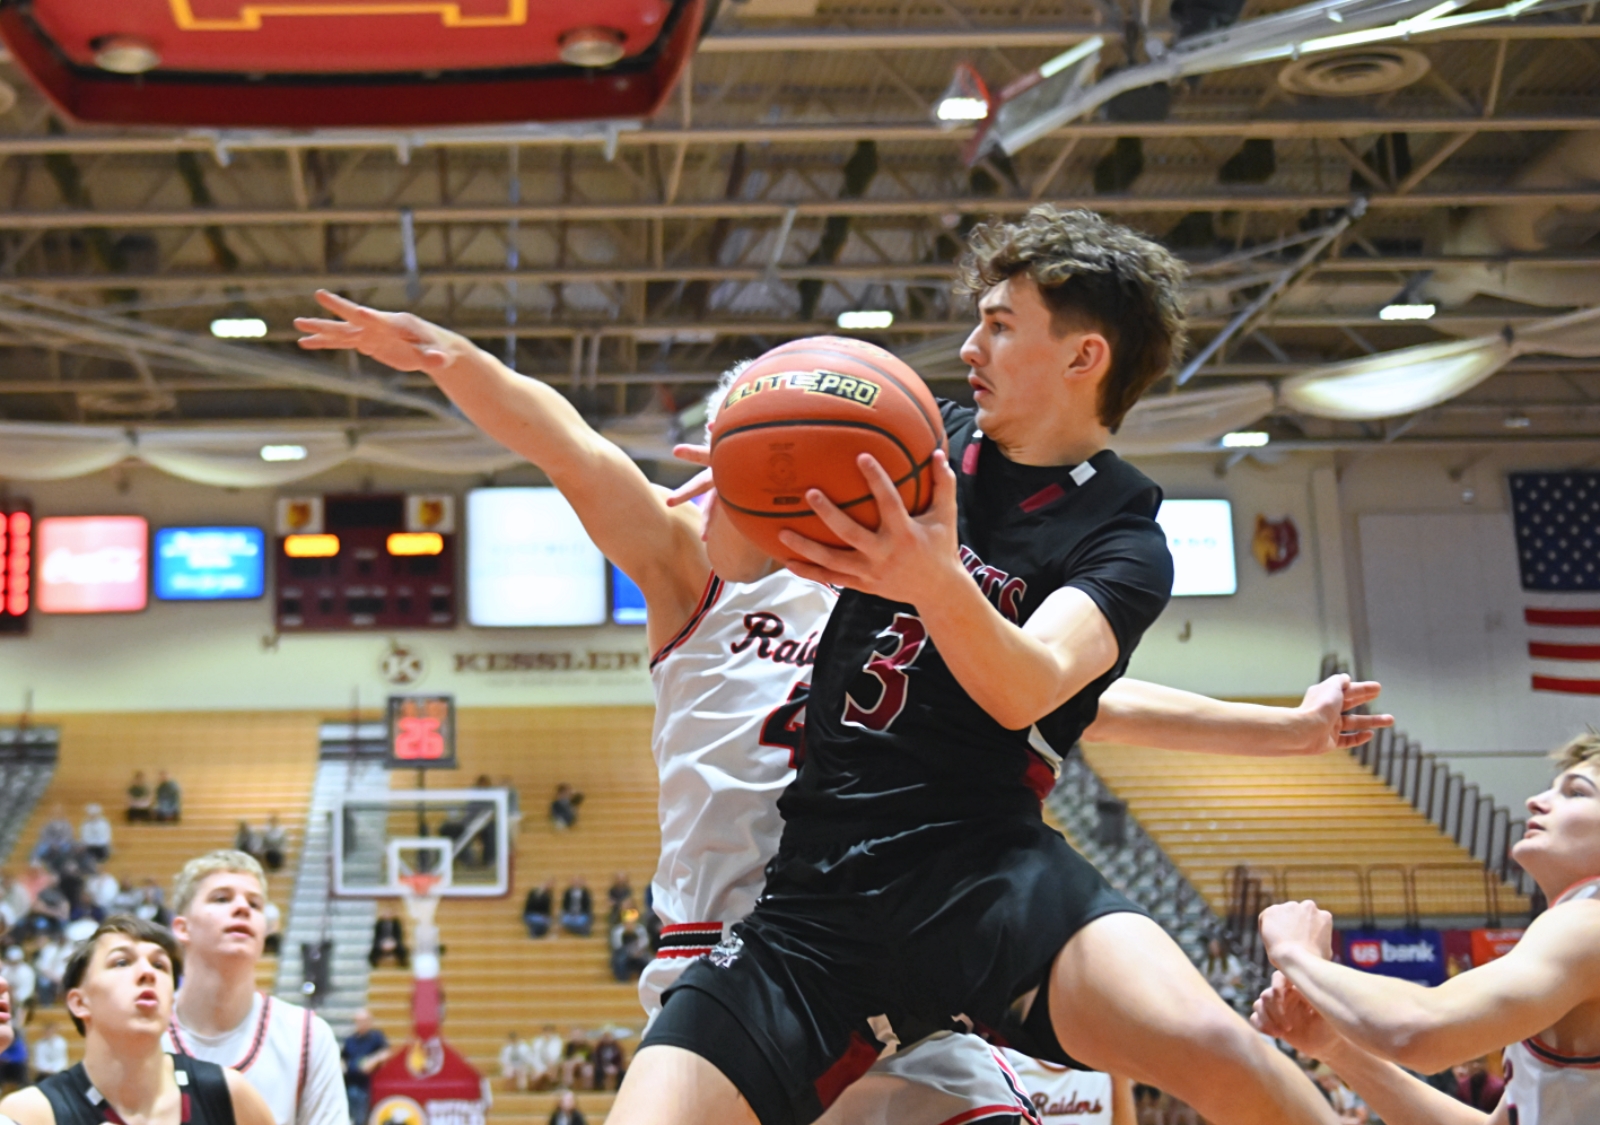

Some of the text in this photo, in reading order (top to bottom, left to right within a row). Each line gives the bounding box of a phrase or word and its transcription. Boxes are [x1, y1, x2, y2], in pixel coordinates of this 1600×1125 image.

[725, 371, 877, 409] ELITE PRO
[454, 652, 640, 673] KESSLER
[841, 613, 926, 732] 3
[1351, 939, 1436, 963] us bank
[1030, 1090, 1103, 1117] Raiders
